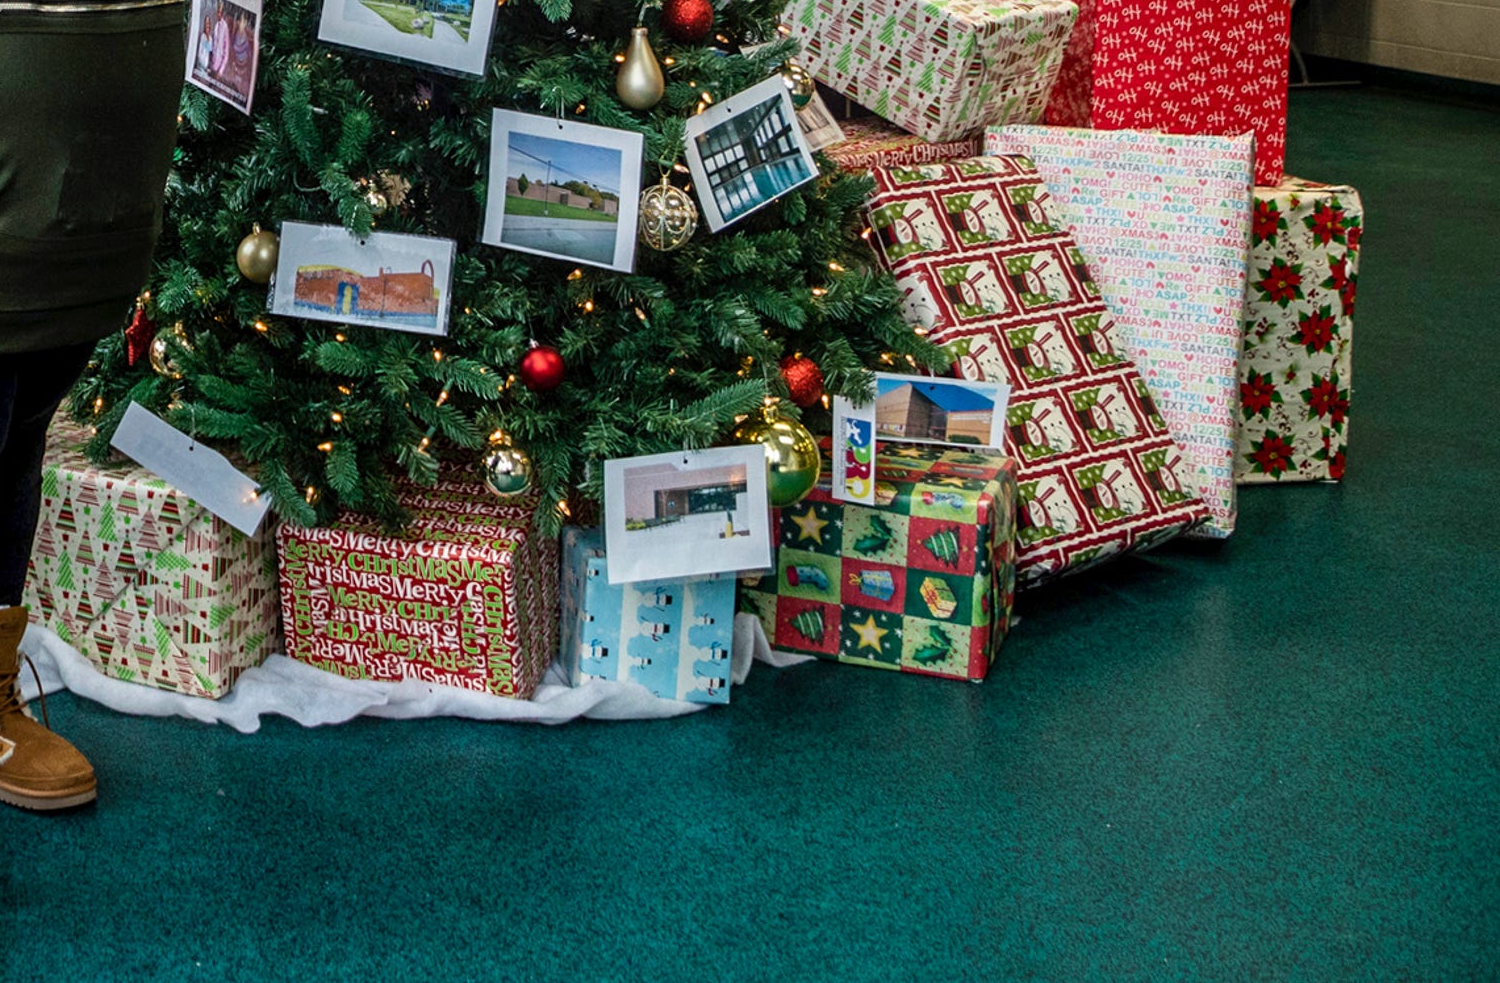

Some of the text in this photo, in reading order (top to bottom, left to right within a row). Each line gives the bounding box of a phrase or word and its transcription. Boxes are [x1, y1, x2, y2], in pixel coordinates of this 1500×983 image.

[1195, 168, 1237, 179] SANTA!
[1071, 196, 1194, 213] ASAP ASAP
[1178, 224, 1198, 234] TXT
[1187, 254, 1230, 266] SANTA!
[1156, 290, 1187, 300] ASAP
[1148, 378, 1180, 388] ASAP
